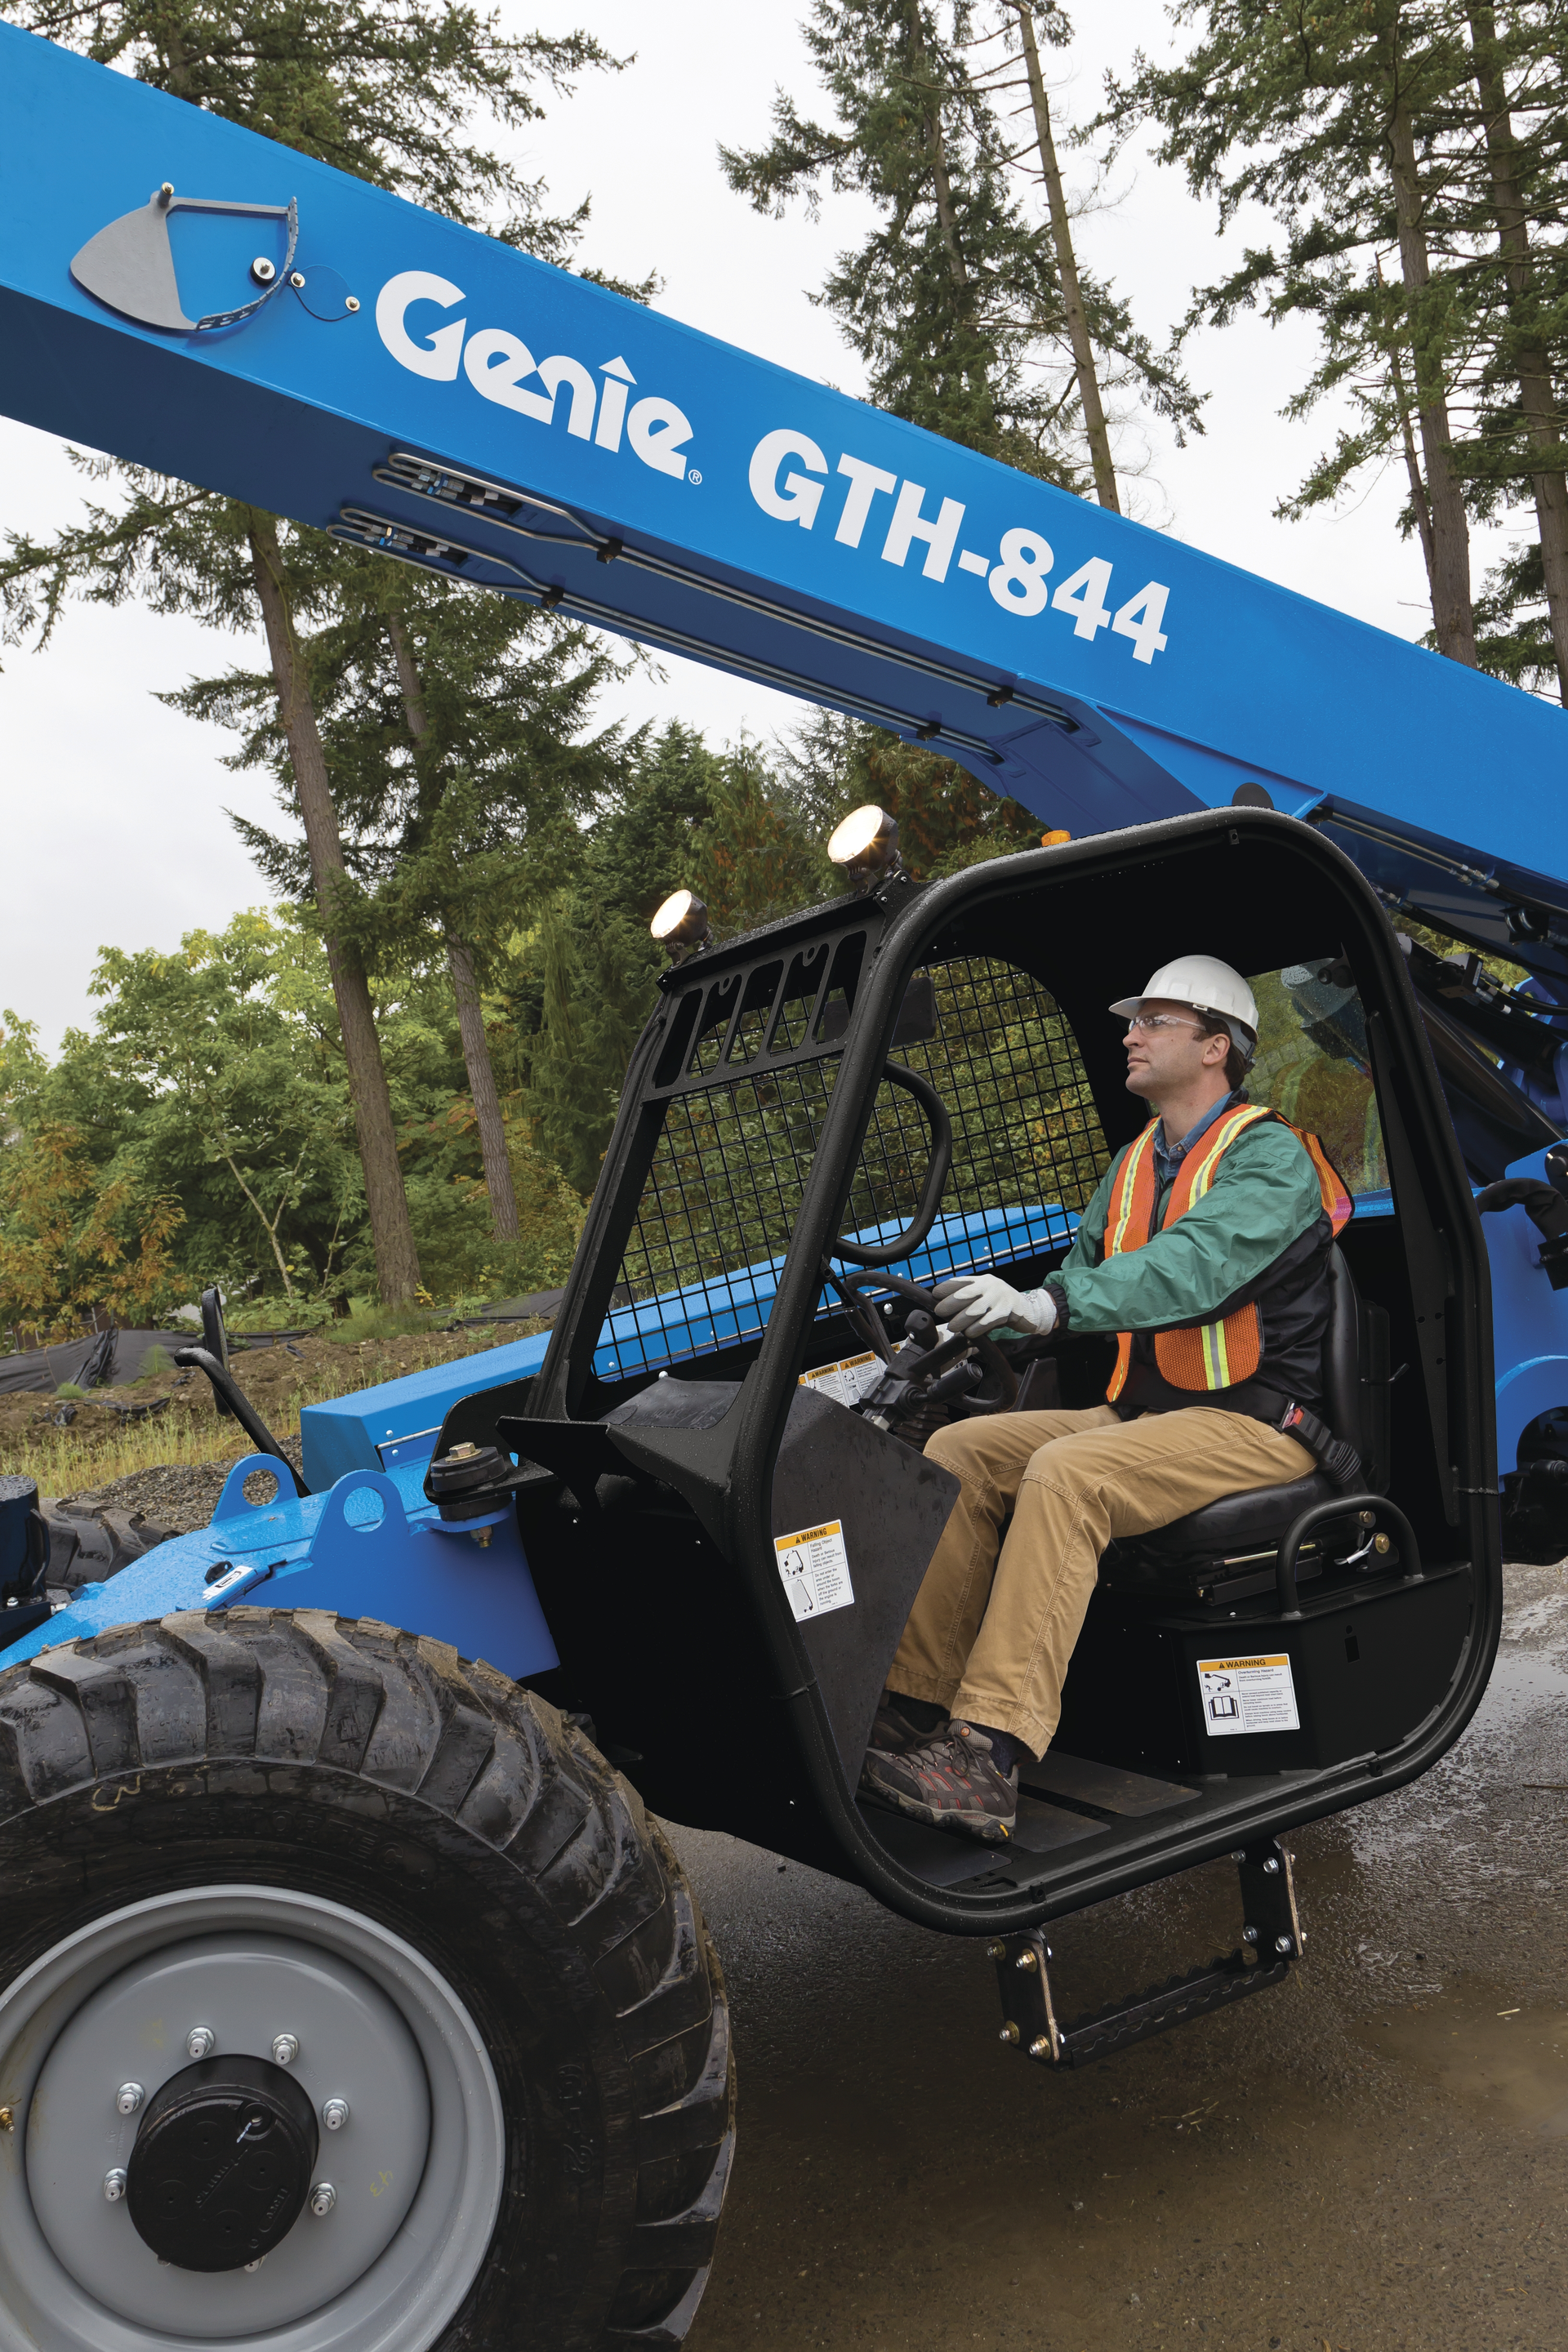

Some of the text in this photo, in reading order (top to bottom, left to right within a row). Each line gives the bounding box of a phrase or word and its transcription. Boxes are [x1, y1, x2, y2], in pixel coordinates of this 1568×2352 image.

[375, 271, 1170, 666] Genie GTH-844
[849, 1355, 871, 1367] WARNING
[815, 1366, 834, 1376] WARNING
[800, 1528, 827, 1542] WARNING
[1226, 1659, 1266, 1668] WARNING
